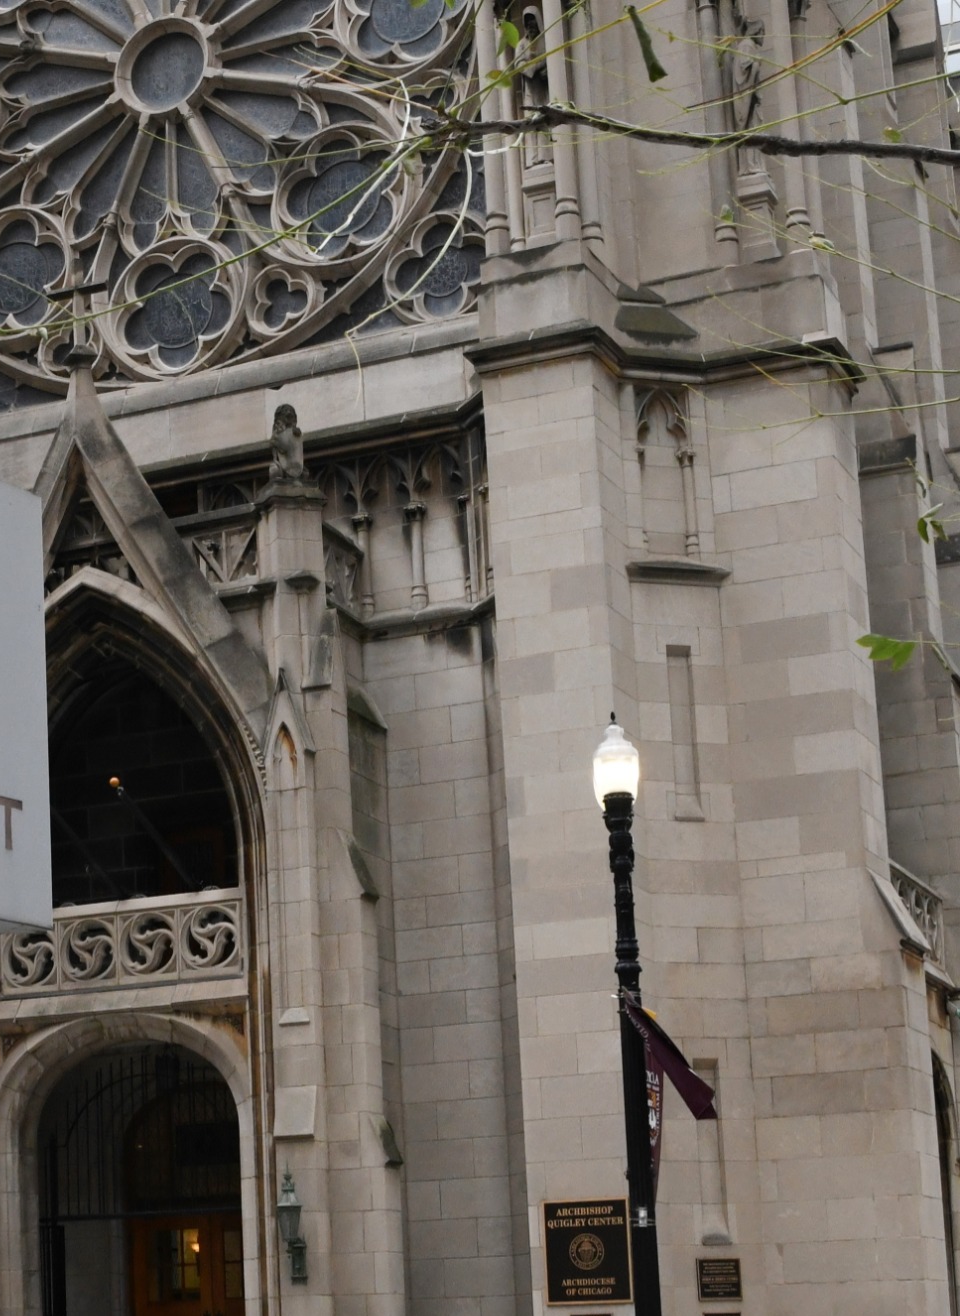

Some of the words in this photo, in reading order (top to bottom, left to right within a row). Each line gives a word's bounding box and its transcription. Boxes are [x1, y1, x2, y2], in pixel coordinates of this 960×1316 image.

[556, 1206, 613, 1216] ARCHBISHOP
[547, 1219, 586, 1229] QUIGLEY
[587, 1217, 623, 1226] CENTER
[562, 1277, 616, 1287] ARCHDIOCESE
[566, 1288, 576, 1296] OF
[577, 1287, 612, 1295] CHICAGO
